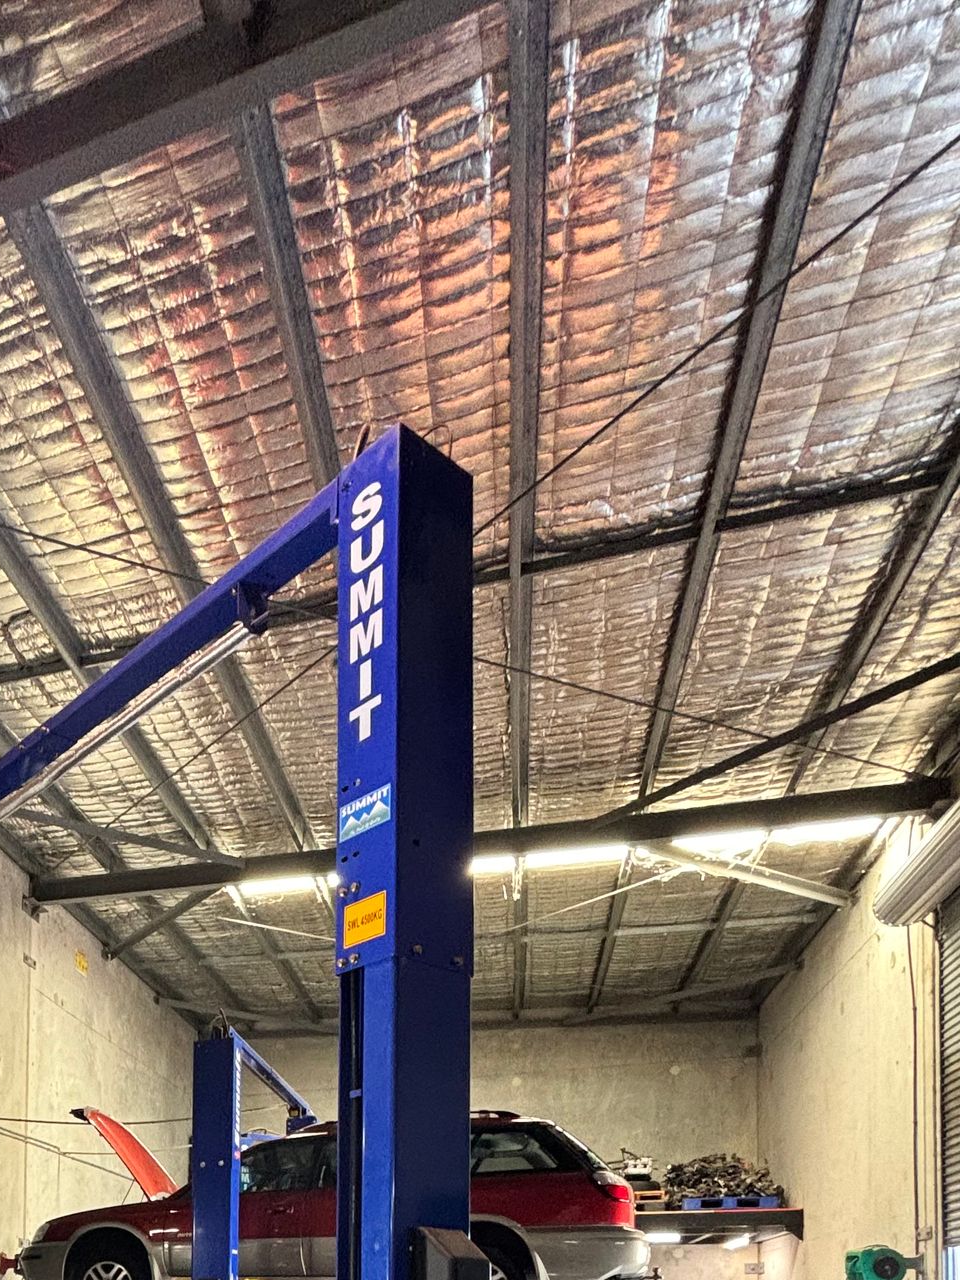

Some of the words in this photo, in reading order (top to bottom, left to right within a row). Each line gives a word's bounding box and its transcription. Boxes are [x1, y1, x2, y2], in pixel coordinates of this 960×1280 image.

[349, 481, 384, 741] SUMMIT
[341, 786, 389, 818] SUMMIT
[348, 917, 360, 931] SWL
[361, 908, 382, 925] 4500KG
